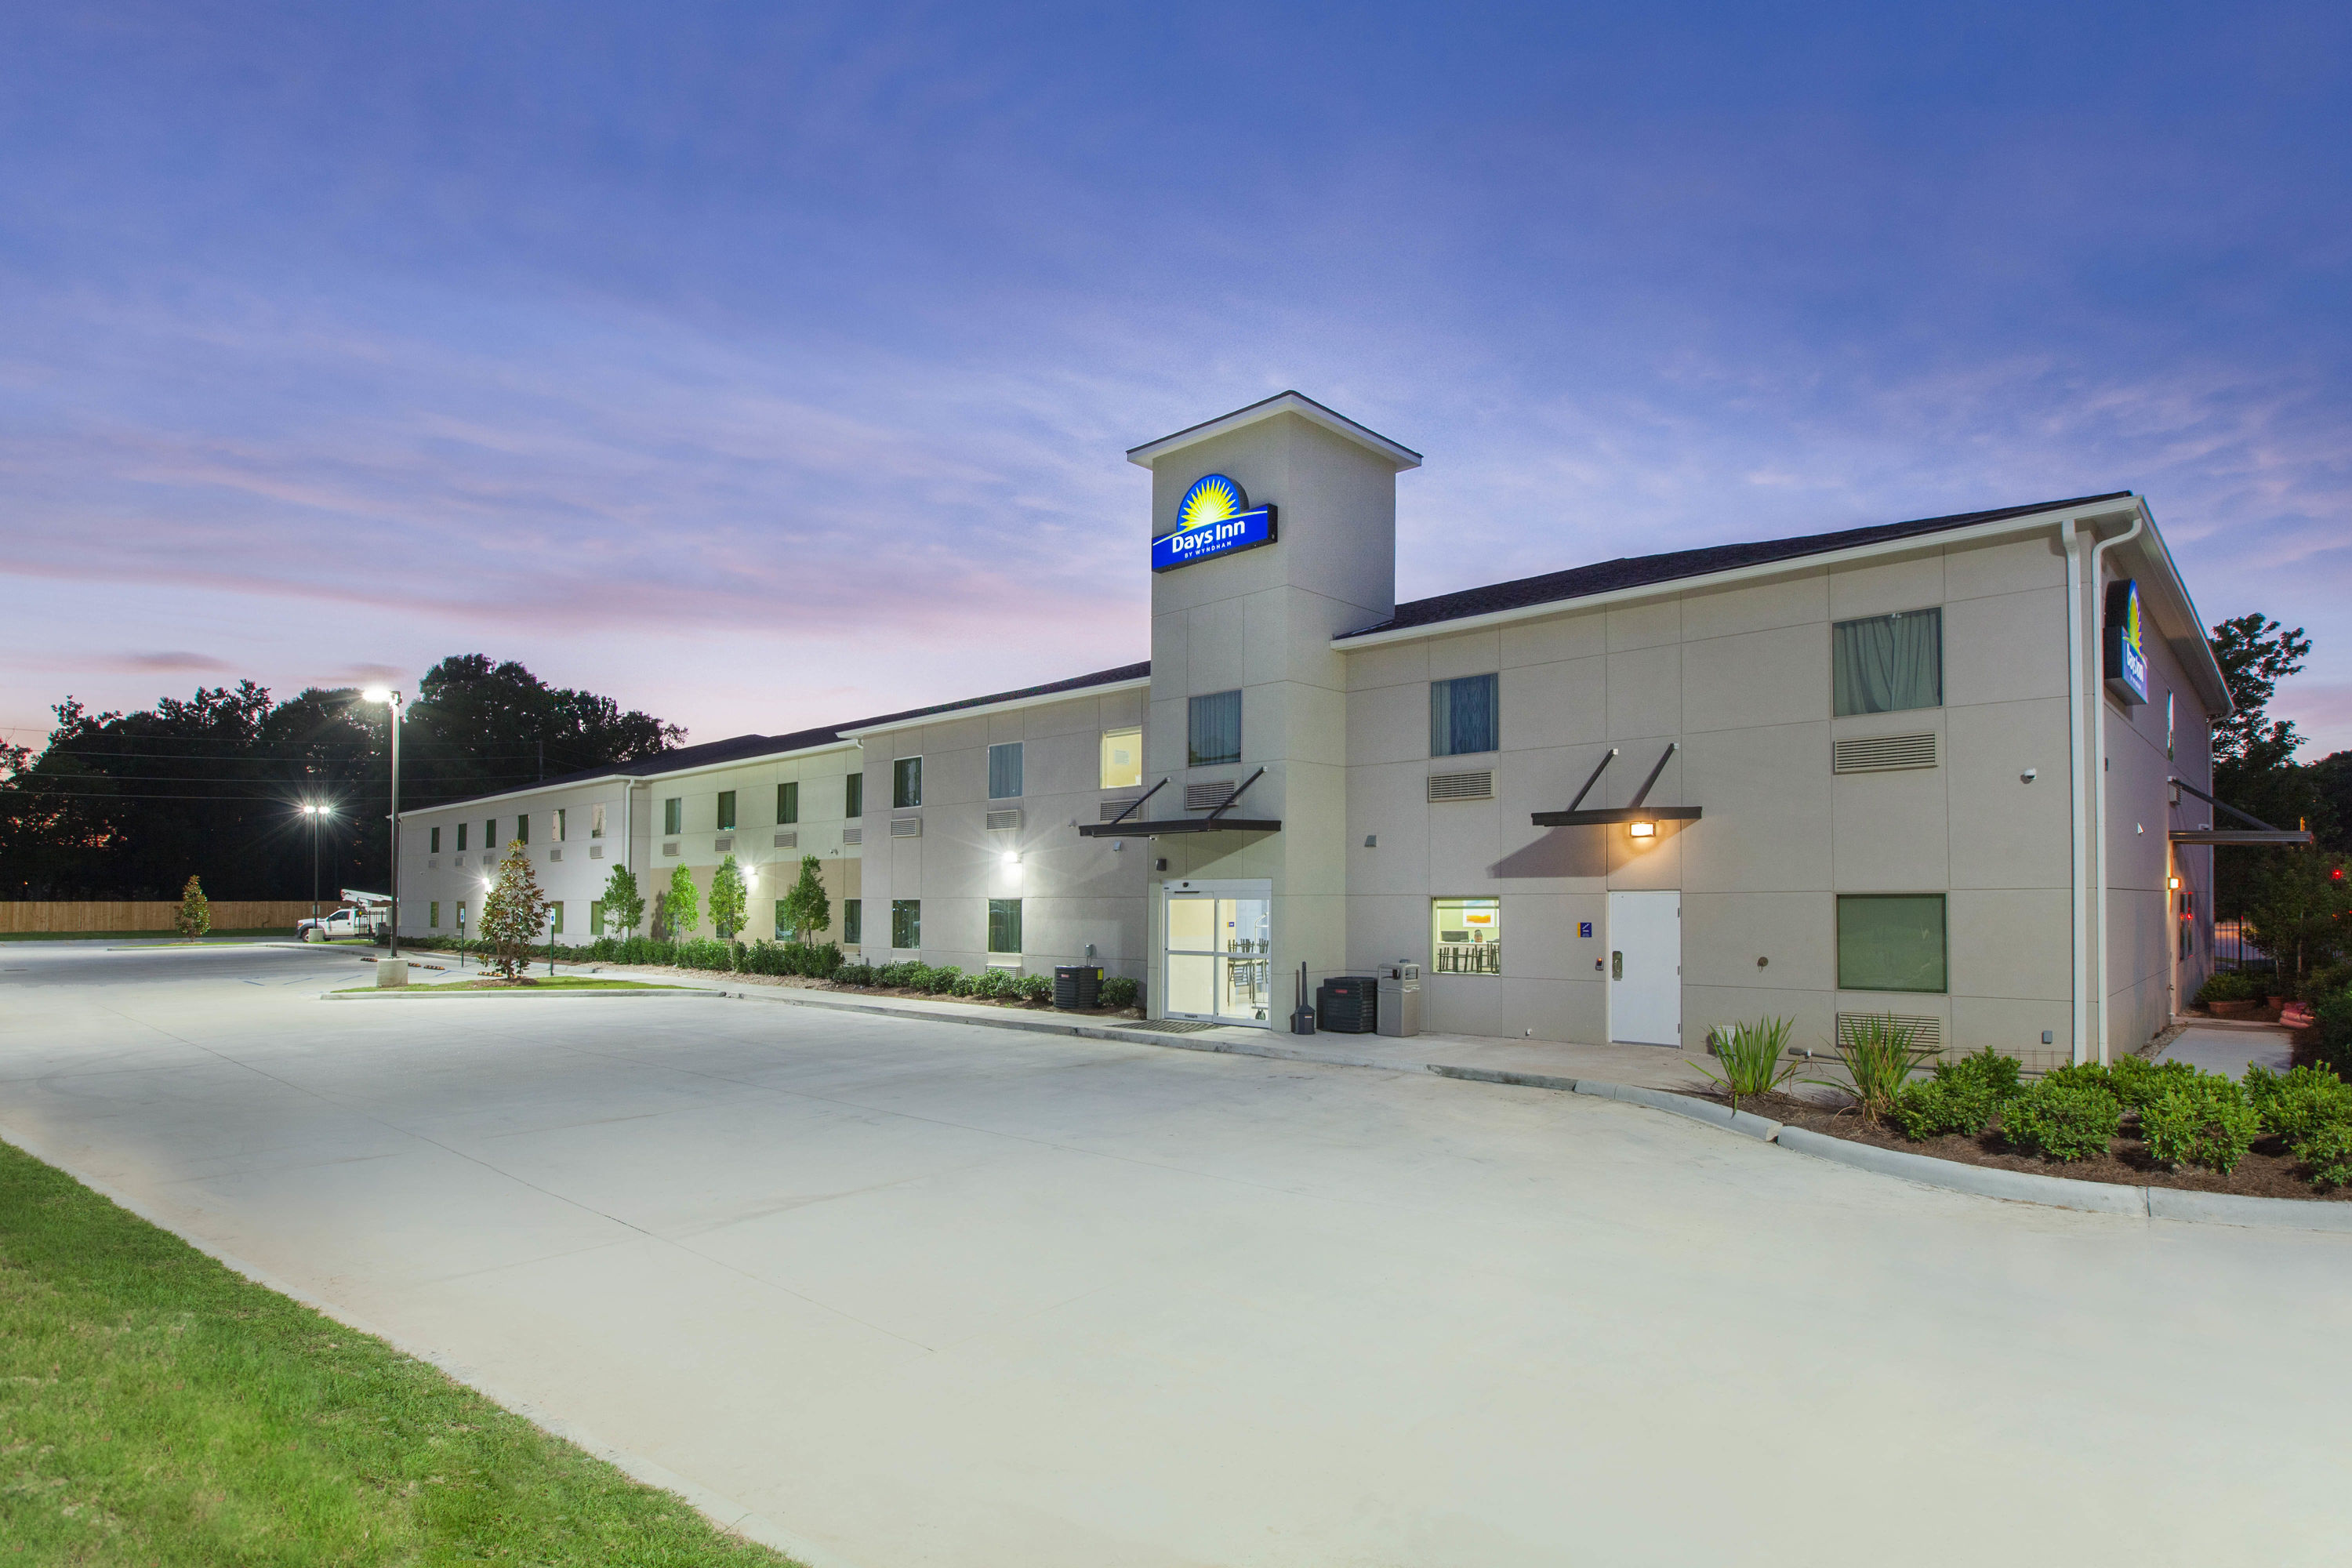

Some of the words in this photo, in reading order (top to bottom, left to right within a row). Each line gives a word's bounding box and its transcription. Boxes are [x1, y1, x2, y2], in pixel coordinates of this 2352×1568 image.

[1172, 530, 1214, 554] Days
[1216, 521, 1245, 541] Inn
[1195, 541, 1232, 555] WYNDHAM
